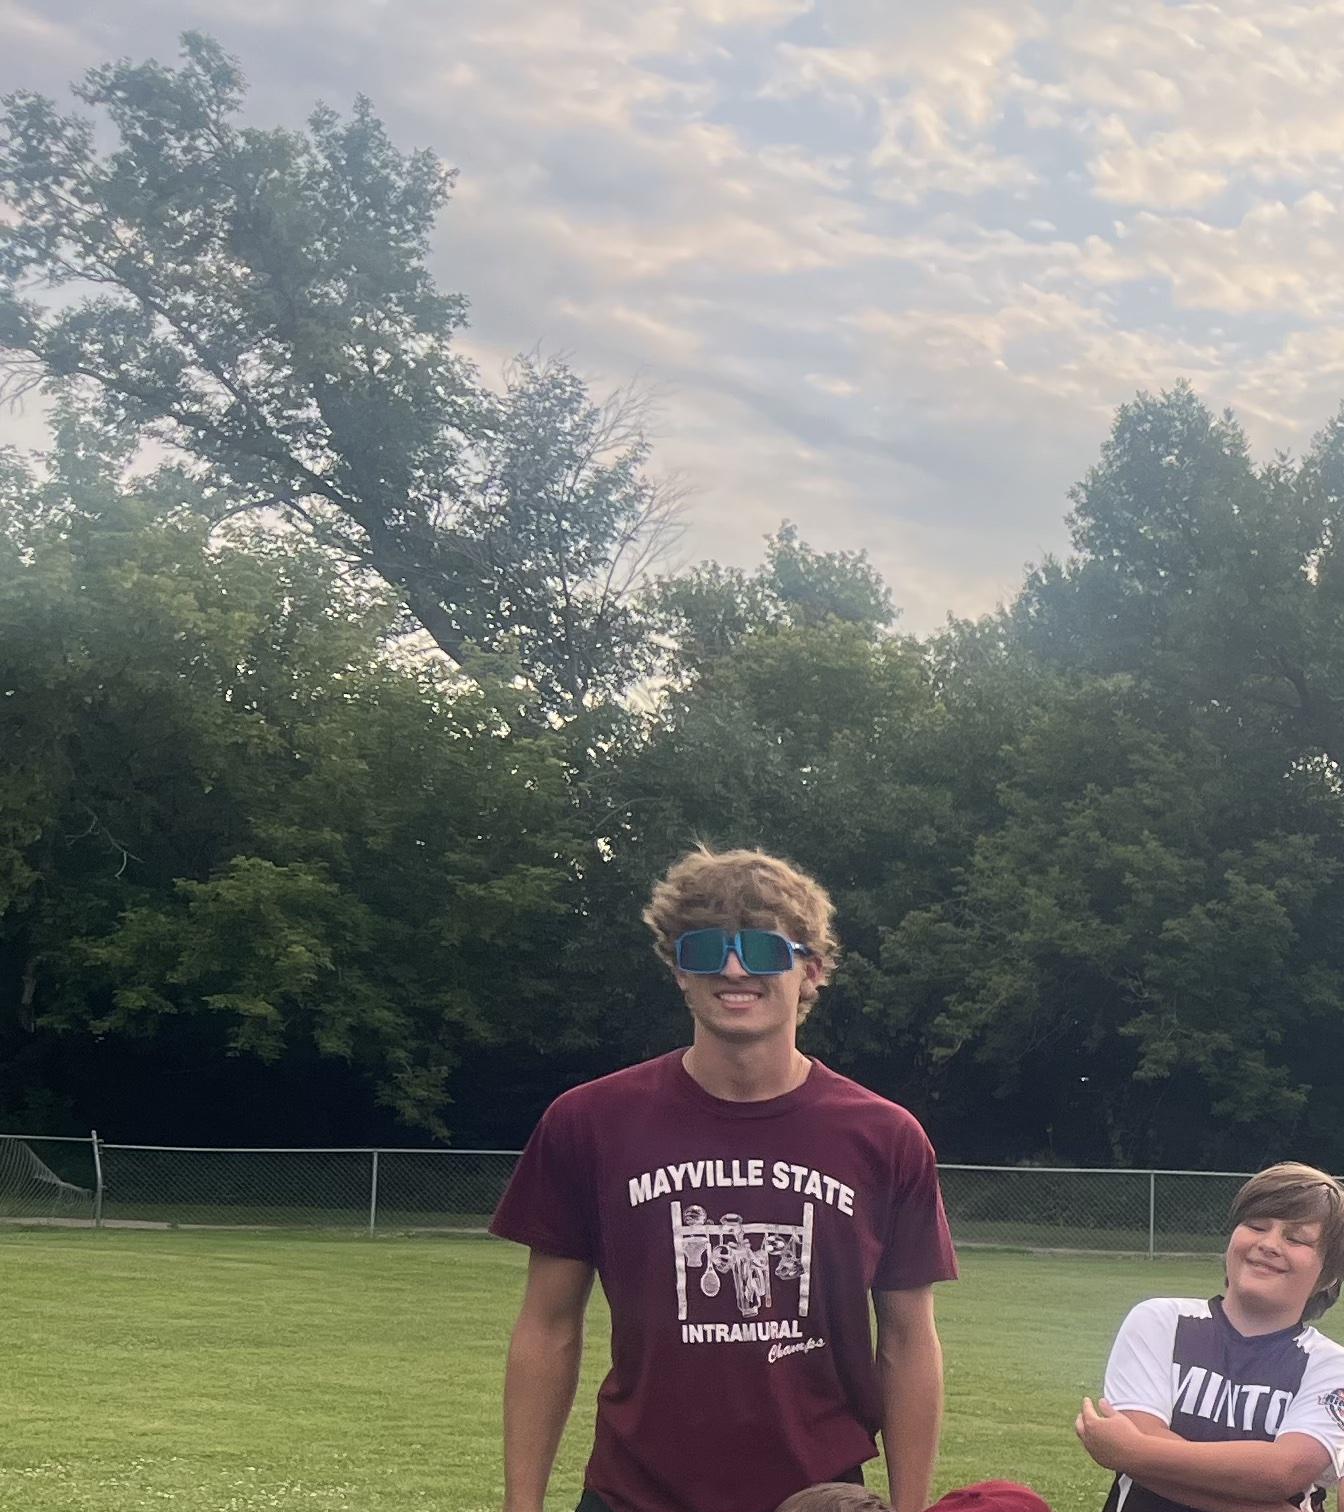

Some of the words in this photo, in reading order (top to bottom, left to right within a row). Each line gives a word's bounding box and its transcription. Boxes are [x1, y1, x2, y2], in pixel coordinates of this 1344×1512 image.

[628, 1159, 764, 1207] MAYVILLE
[771, 1160, 855, 1217] STATE
[681, 1320, 803, 1346] INTRAMURAL
[767, 1337, 827, 1365] Champs
